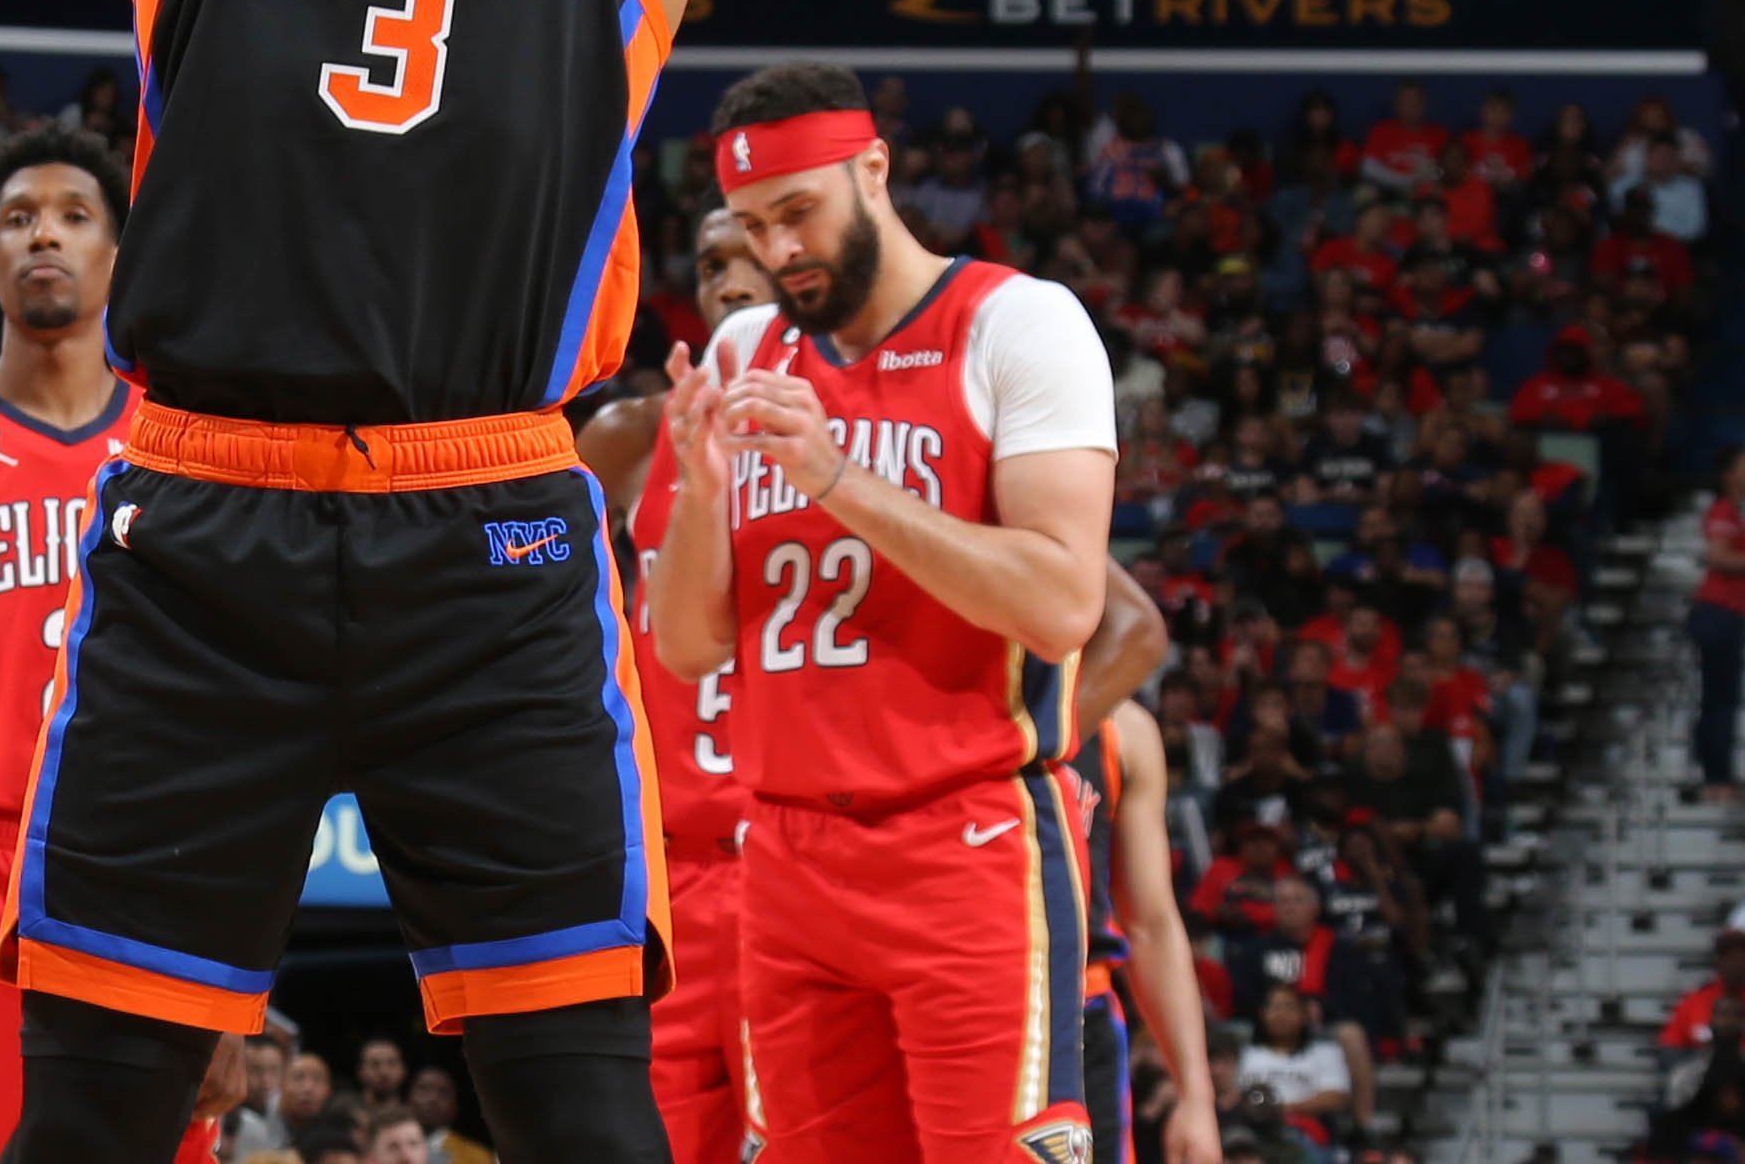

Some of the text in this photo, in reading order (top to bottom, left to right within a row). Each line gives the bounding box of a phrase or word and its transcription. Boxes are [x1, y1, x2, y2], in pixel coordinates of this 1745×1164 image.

[877, 349, 943, 372] ibotta
[484, 517, 571, 566] NYC
[762, 536, 873, 674] 22
